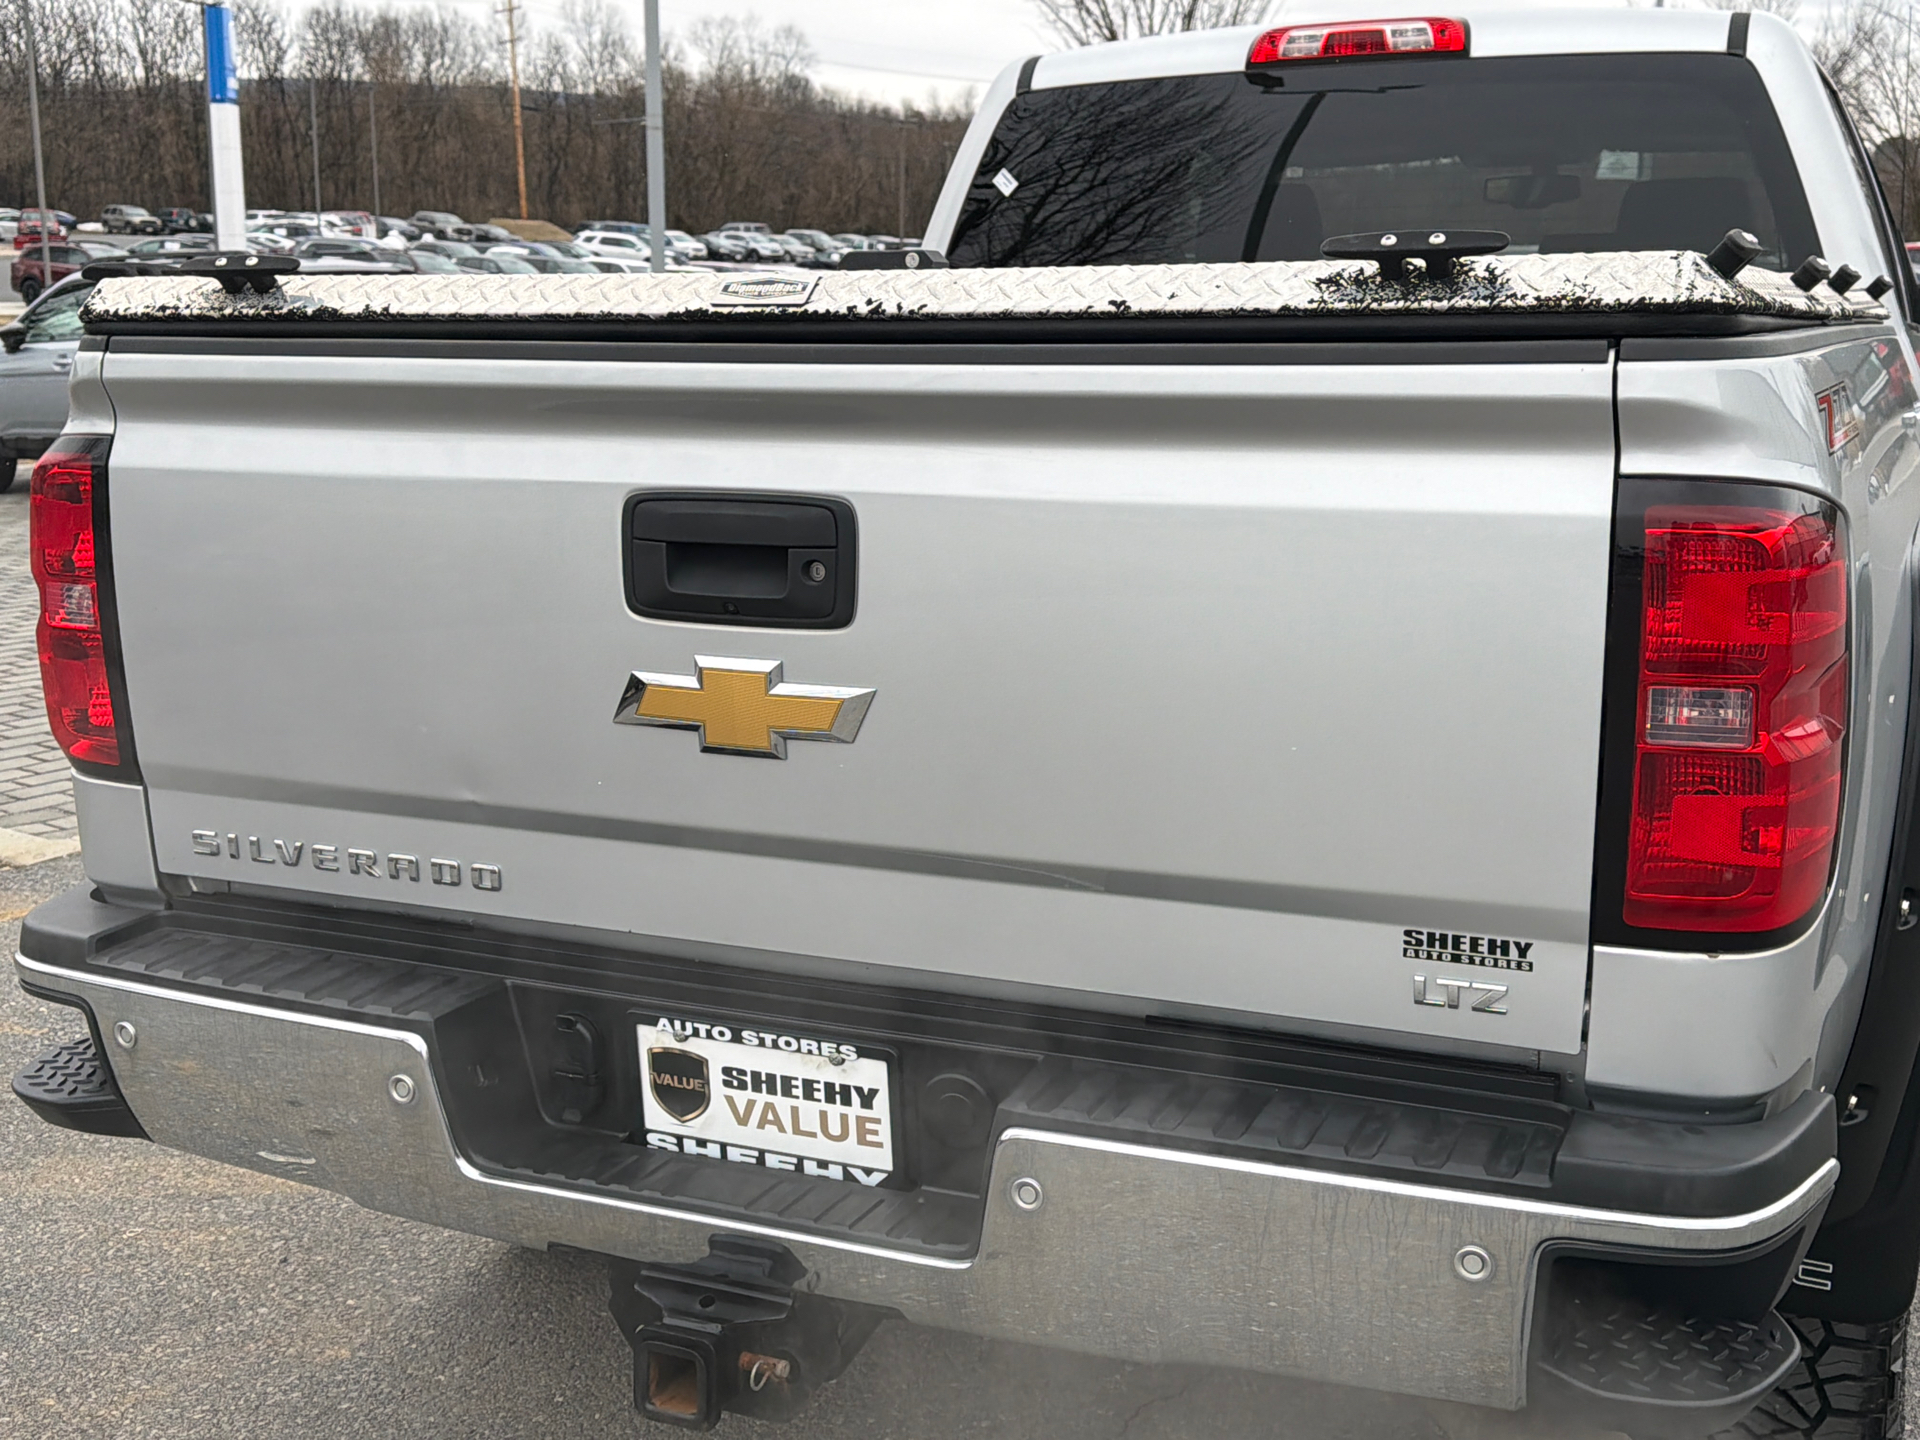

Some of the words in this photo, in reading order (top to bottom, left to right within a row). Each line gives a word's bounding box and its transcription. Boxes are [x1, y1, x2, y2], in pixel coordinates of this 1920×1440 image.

[727, 282, 804, 293] DiamondBack
[191, 829, 502, 892] SILVERADO
[1402, 929, 1534, 959] SHEEHY
[1405, 948, 1452, 962] AUTO
[1460, 955, 1531, 971] STORES
[1413, 974, 1509, 1015] LTZ
[655, 1017, 732, 1042] AUTO
[741, 1030, 859, 1061] STORES
[653, 1071, 705, 1092] VALUE
[721, 1065, 881, 1110] SHEEHY
[723, 1094, 885, 1149] VALUE
